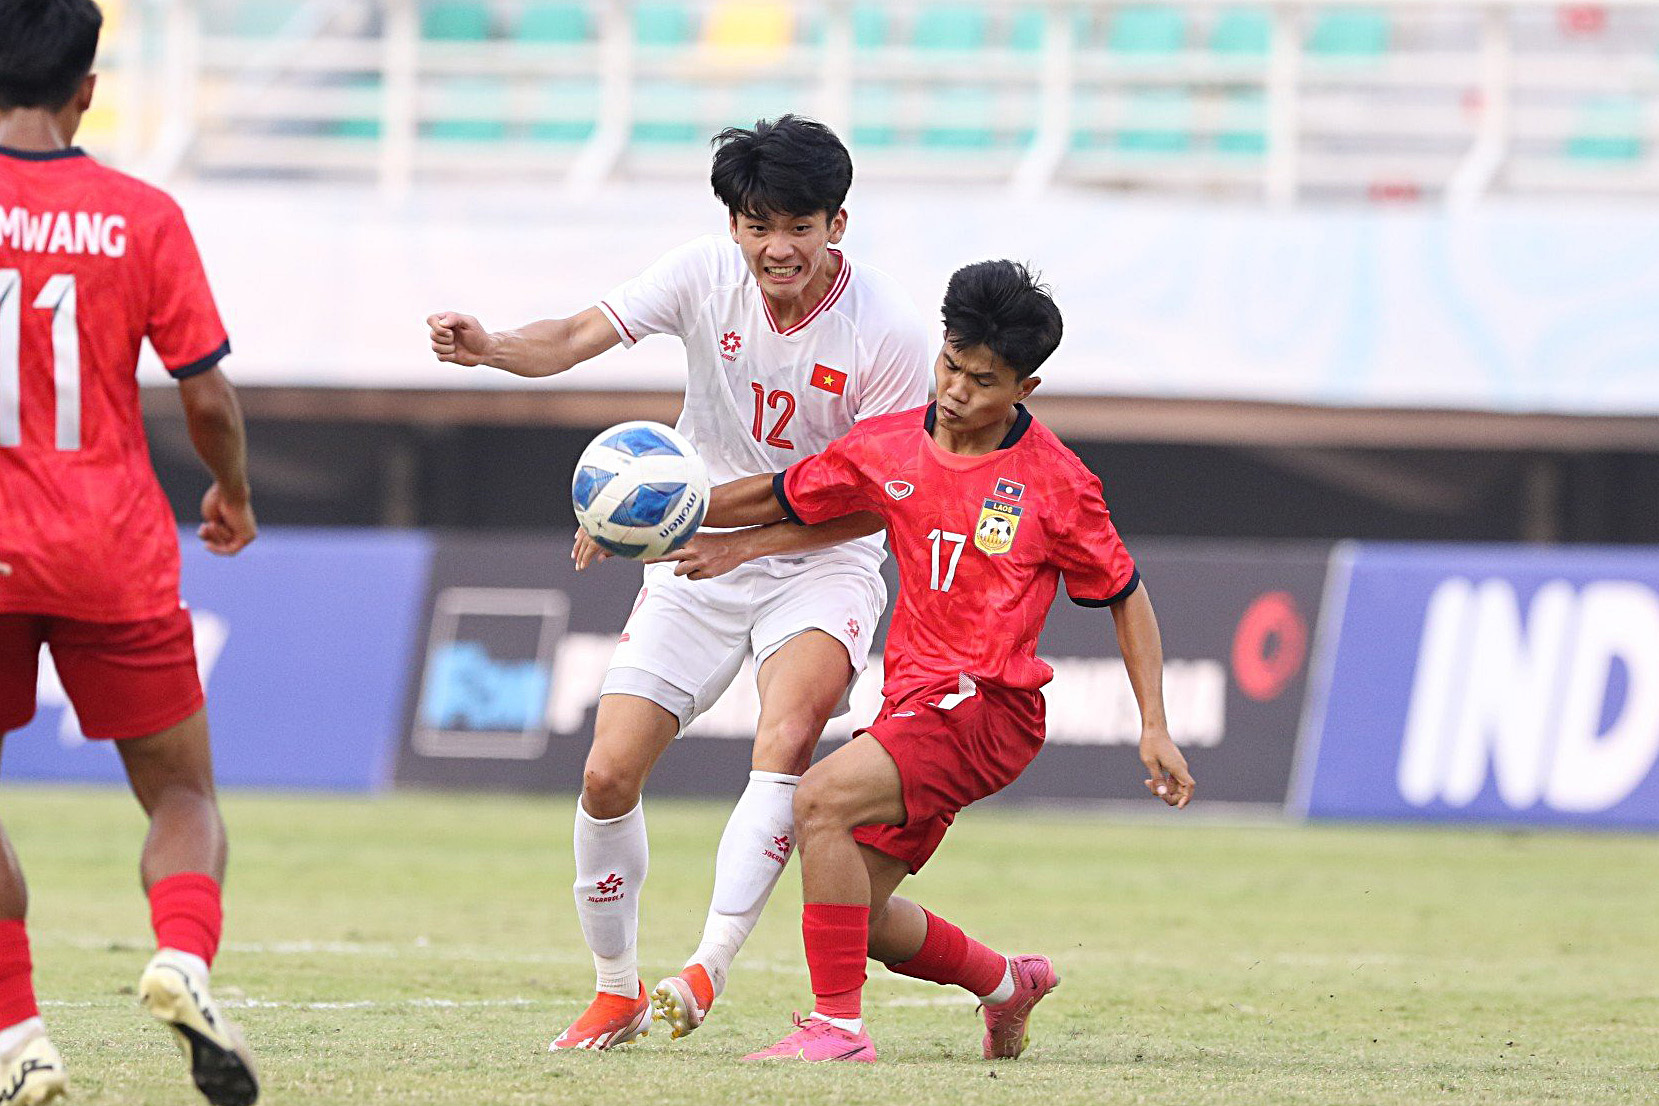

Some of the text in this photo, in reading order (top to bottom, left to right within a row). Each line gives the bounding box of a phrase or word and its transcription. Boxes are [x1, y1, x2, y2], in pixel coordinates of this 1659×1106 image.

[0, 206, 126, 258] MWANG
[0, 268, 81, 451] 11
[751, 381, 796, 450] 12
[659, 492, 697, 538] molten
[993, 502, 1014, 514] LAOS
[927, 528, 967, 593] 17
